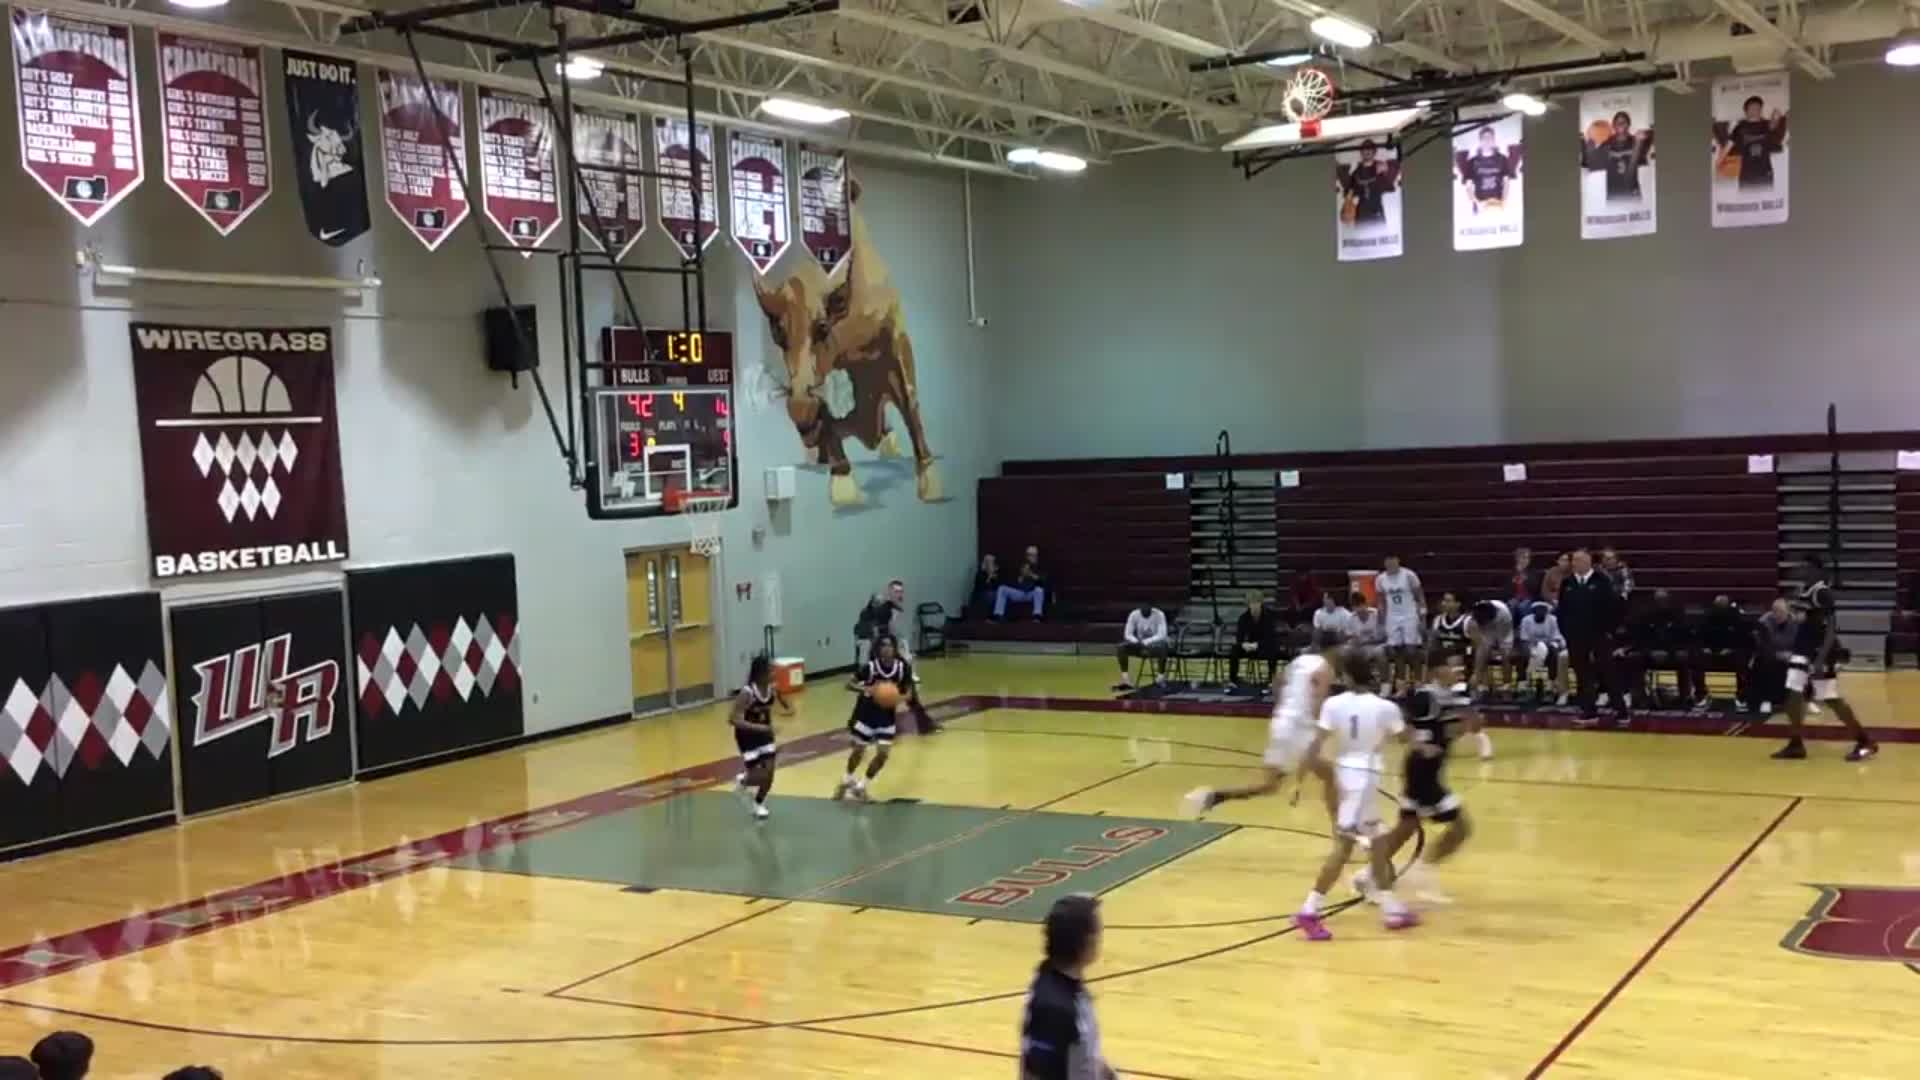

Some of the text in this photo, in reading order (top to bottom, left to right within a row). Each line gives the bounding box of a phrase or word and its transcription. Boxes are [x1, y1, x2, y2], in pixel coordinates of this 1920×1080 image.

[287, 57, 316, 79] JUST
[319, 64, 338, 82] DO
[136, 328, 328, 352] WIREGRASS
[621, 368, 649, 384] BULLS
[627, 391, 653, 417] 42
[672, 390, 685, 412] 4
[629, 431, 641, 457] 3
[155, 540, 345, 577] BASKETBALL
[1348, 713, 1360, 740] 1
[944, 825, 1169, 909] BULLS
